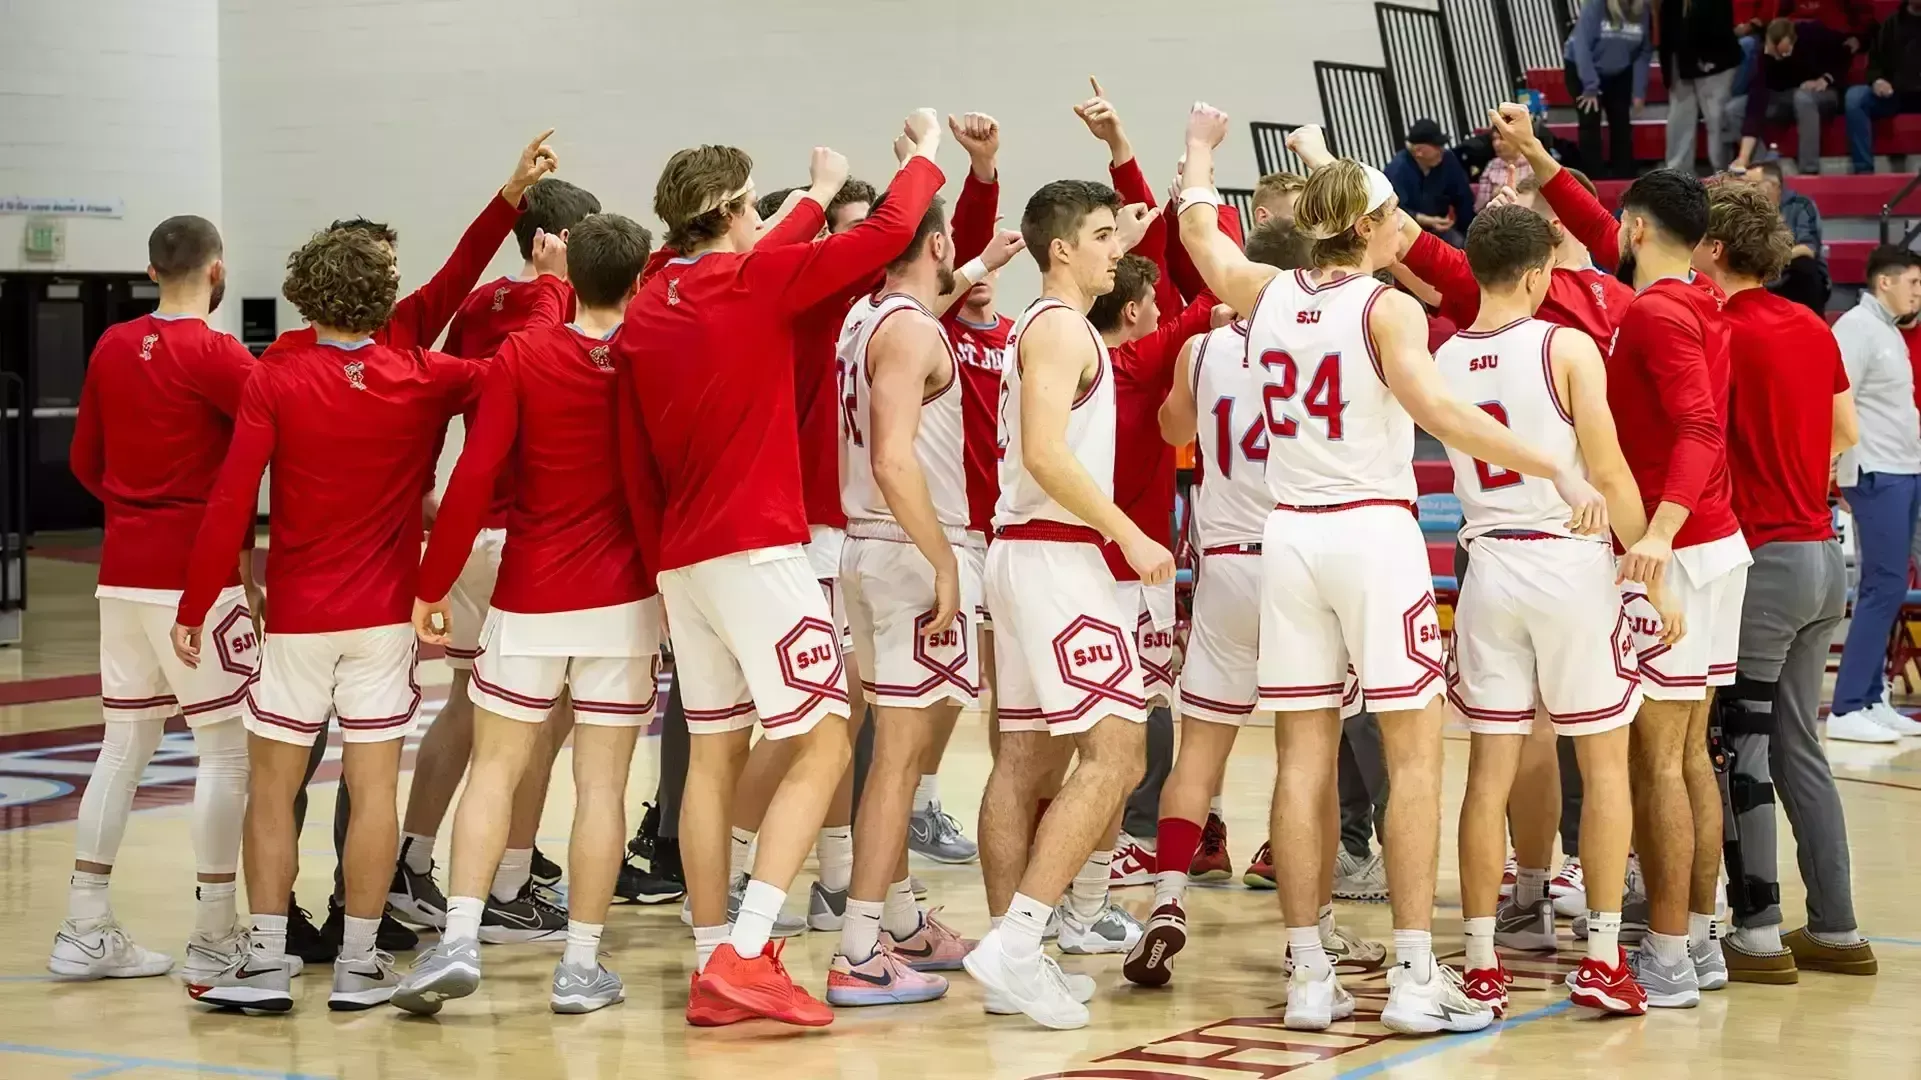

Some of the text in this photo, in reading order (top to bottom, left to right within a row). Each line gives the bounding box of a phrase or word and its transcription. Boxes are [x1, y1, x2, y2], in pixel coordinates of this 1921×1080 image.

[1469, 354, 1498, 371] SJU
[1259, 348, 1350, 441] 24
[1211, 395, 1270, 484] 14
[1628, 616, 1657, 635] JU
[929, 629, 957, 647] SJU
[1143, 632, 1171, 648] SJU
[797, 643, 831, 669] SJU
[1073, 644, 1112, 667] SJU
